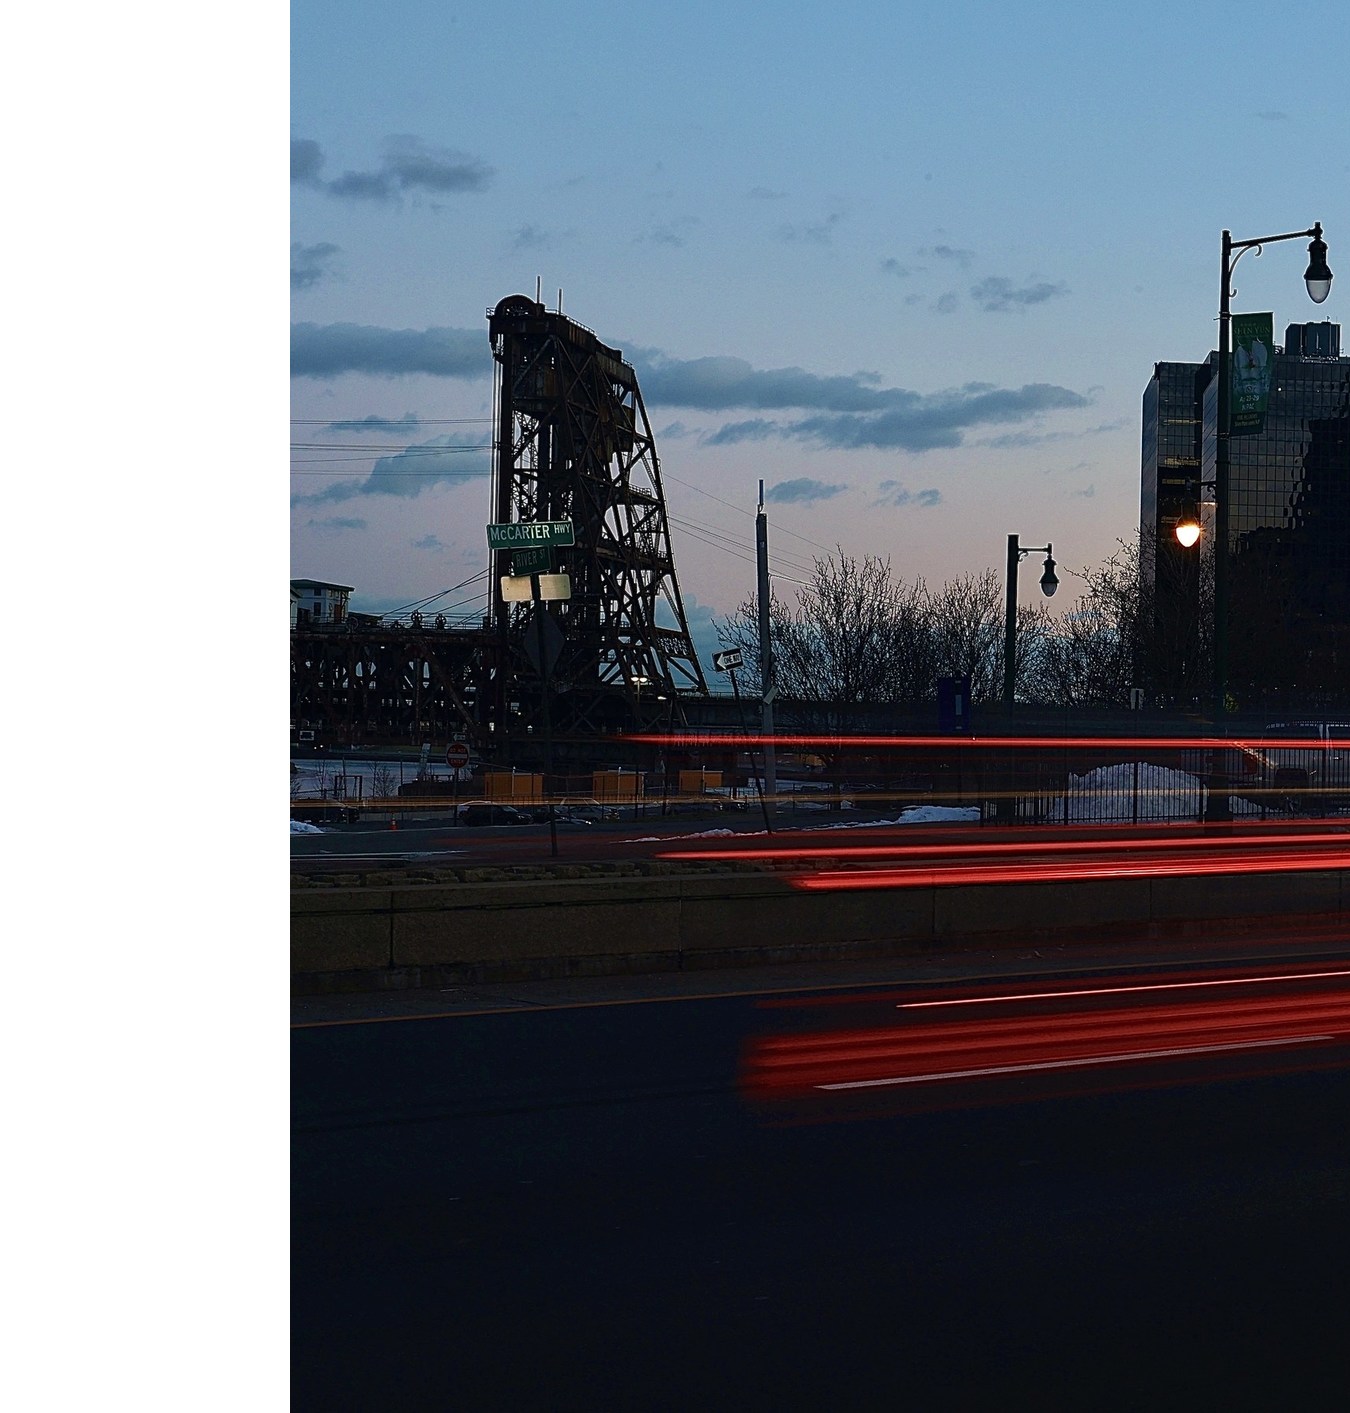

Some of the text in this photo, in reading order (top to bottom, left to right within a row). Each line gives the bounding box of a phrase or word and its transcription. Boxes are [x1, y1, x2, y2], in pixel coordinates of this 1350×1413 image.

[490, 524, 570, 541] McCARTER HWY
[516, 548, 546, 568] RIVER ST
[723, 655, 733, 665] ONE
